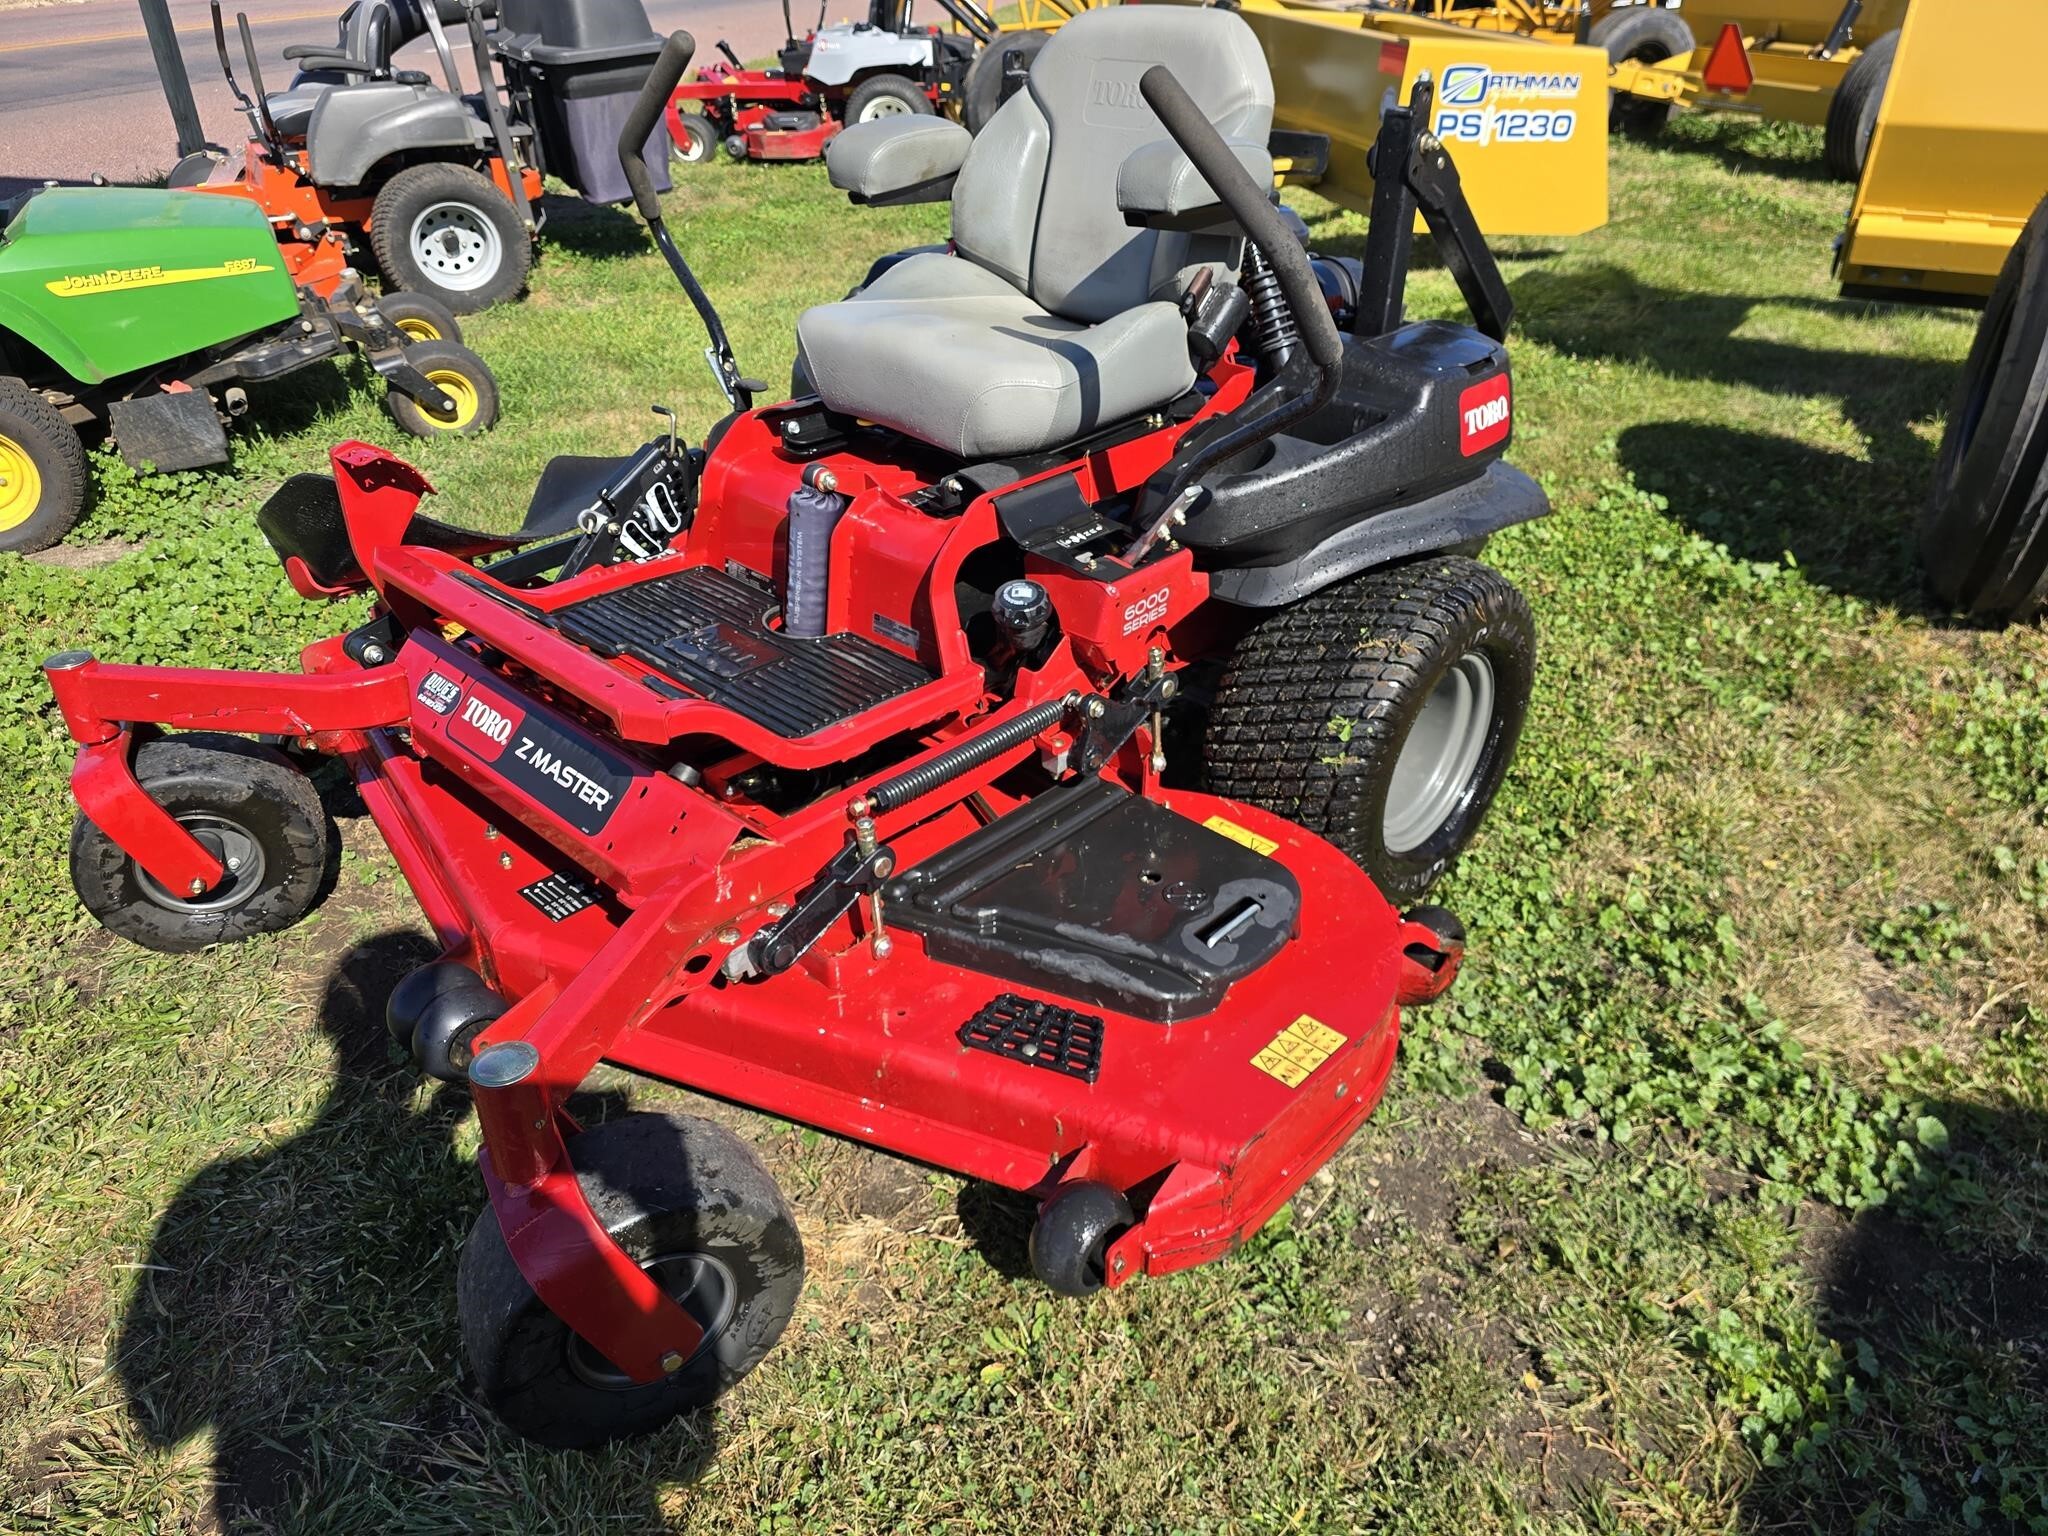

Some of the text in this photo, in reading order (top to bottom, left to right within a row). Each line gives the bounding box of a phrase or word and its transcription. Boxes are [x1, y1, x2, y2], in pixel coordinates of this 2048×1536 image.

[1093, 79, 1147, 110] TOR
[1464, 394, 1509, 436] TORO
[1122, 602, 1168, 637] SERIES
[1124, 587, 1170, 621] 6000
[461, 696, 512, 743] TORO
[514, 736, 611, 812] Z MASTER
